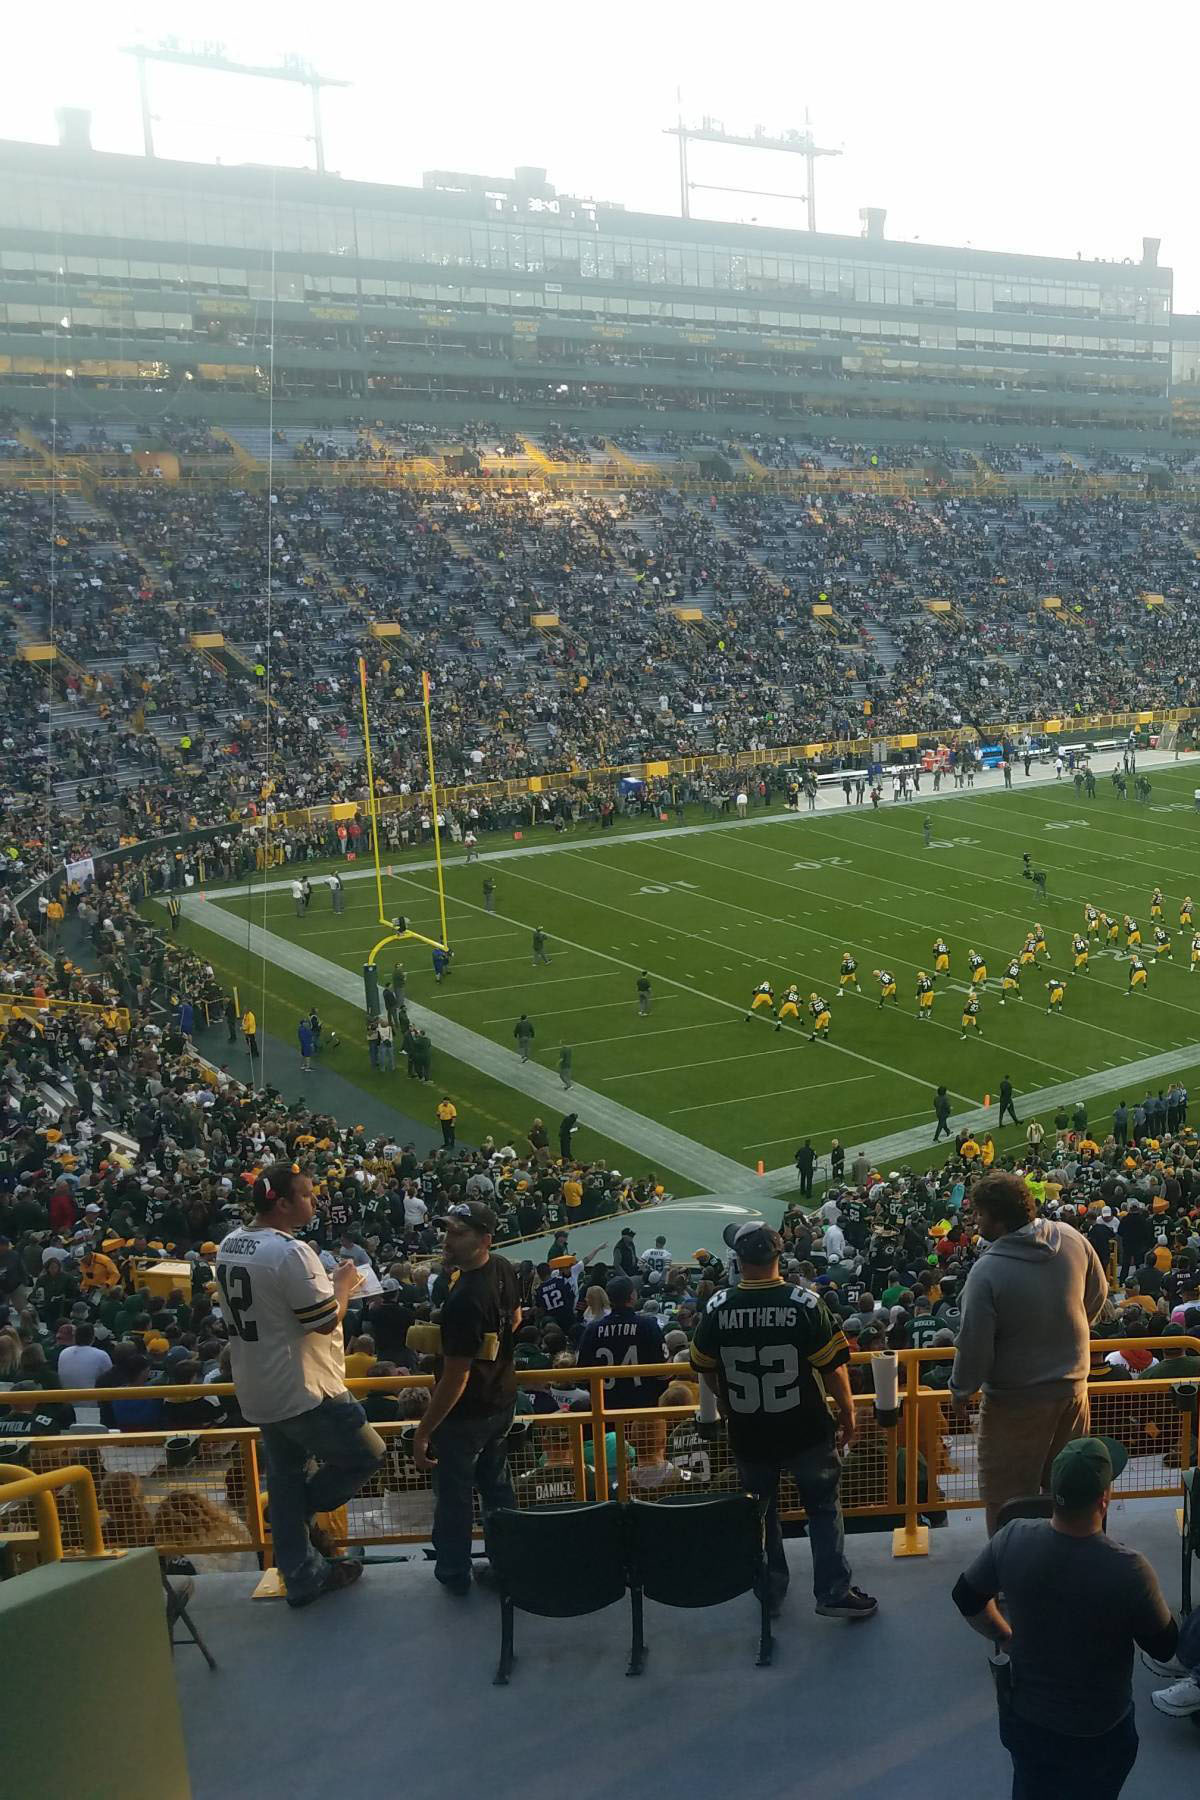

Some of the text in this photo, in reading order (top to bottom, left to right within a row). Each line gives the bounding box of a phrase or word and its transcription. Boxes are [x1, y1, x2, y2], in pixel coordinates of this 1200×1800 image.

[331, 1210, 347, 1224] 55
[1153, 1225, 1165, 1238] 21
[222, 1239, 257, 1256] RODGERS
[648, 1257, 664, 1271] 92
[216, 1263, 259, 1342] 12
[541, 1288, 565, 1311] 12
[789, 1287, 821, 1310] 5
[847, 1290, 859, 1303] 21
[718, 1306, 798, 1330] MATTHEWS
[597, 1323, 638, 1339] PAYTON
[911, 1330, 938, 1349] 12
[719, 1343, 801, 1414] 52
